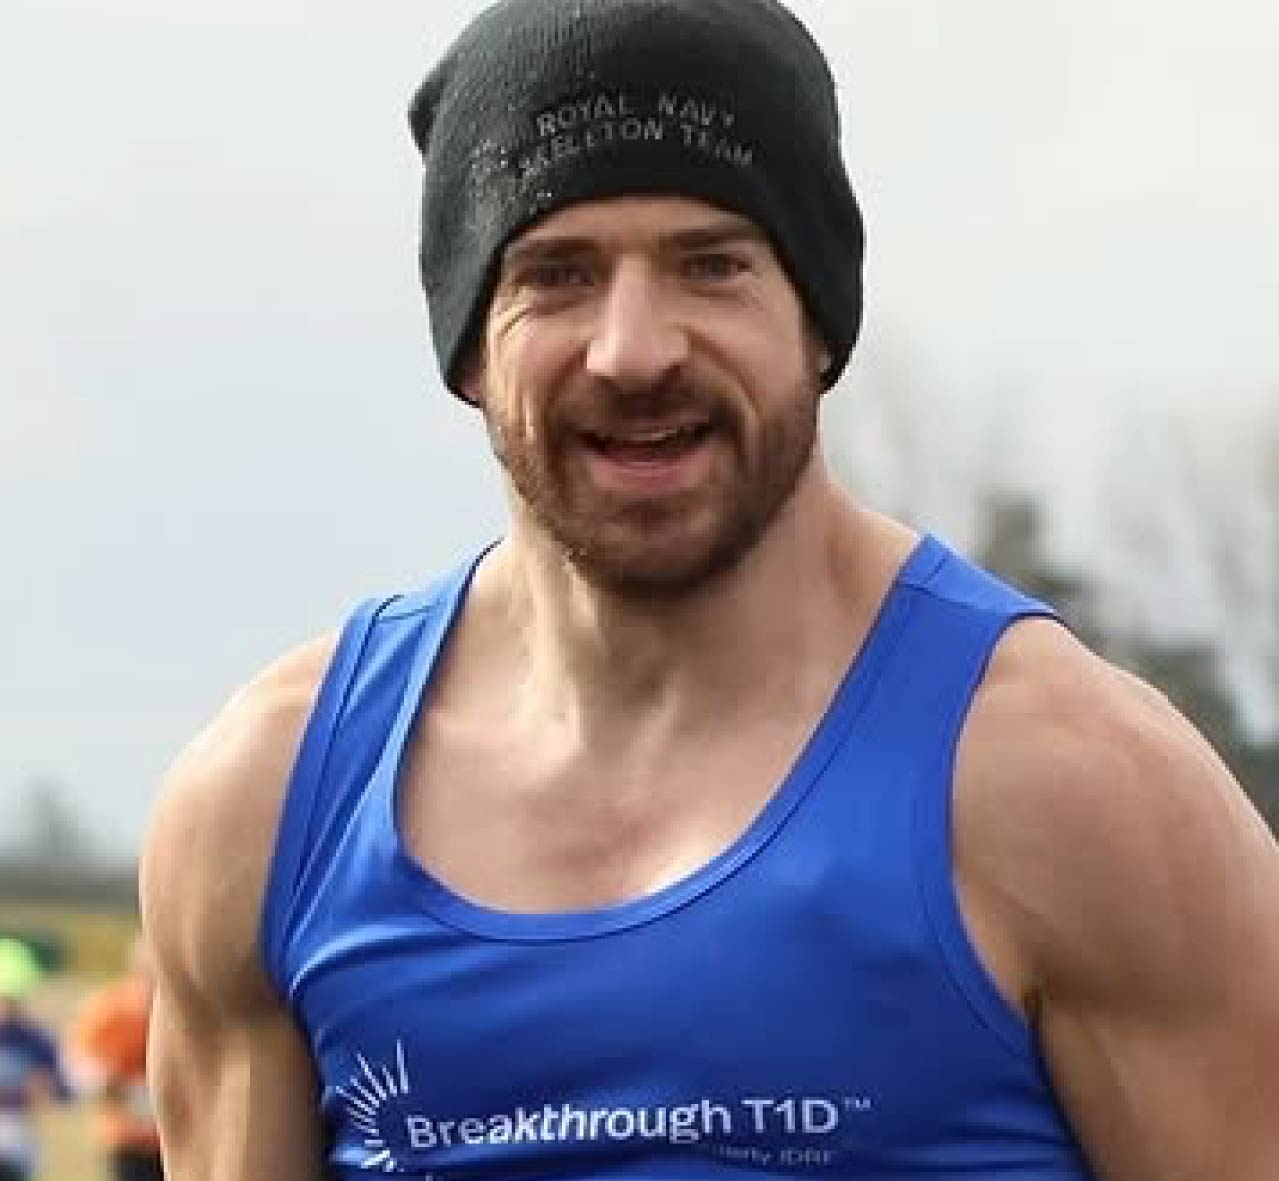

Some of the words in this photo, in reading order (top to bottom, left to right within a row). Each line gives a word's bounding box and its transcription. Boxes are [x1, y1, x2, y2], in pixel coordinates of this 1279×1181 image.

[536, 93, 634, 138] ROYAL
[658, 92, 735, 127] NAVY
[404, 1099, 732, 1149] Breakthrough
